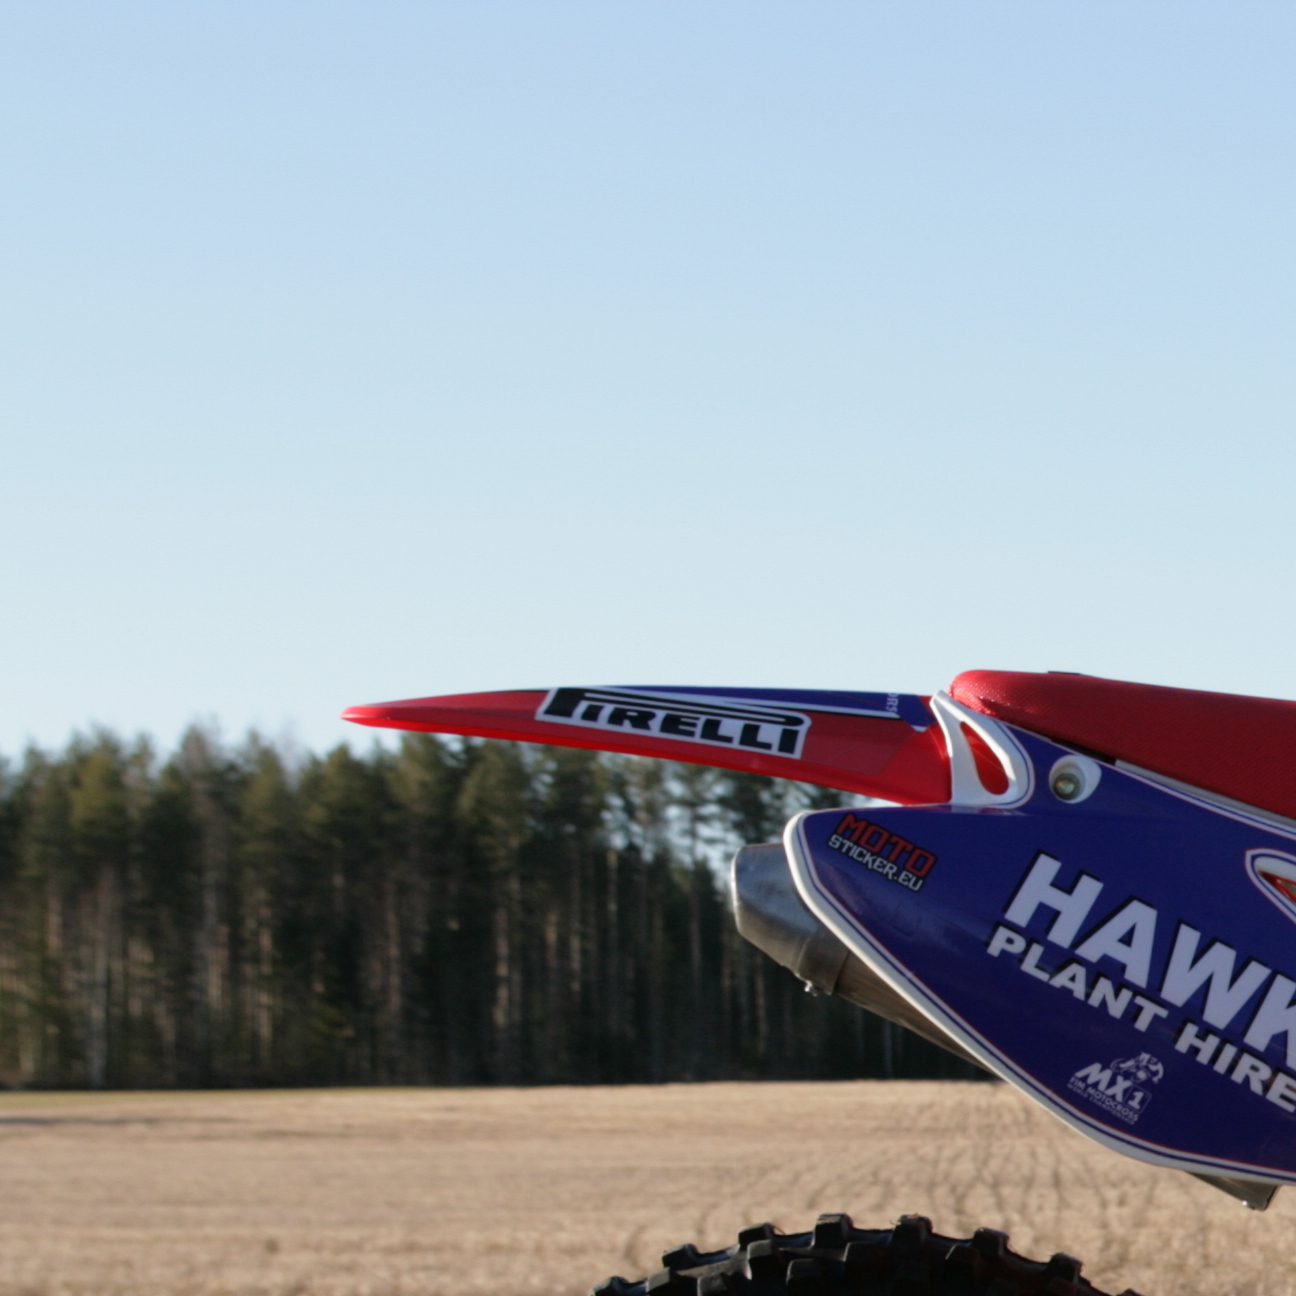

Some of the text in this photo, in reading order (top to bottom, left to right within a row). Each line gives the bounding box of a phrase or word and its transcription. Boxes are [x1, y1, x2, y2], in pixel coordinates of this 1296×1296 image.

[543, 687, 806, 755] PIRELLI
[827, 833, 924, 892] STICKER.EU
[835, 813, 937, 877] MOTO
[986, 925, 1169, 1033] PLANT
